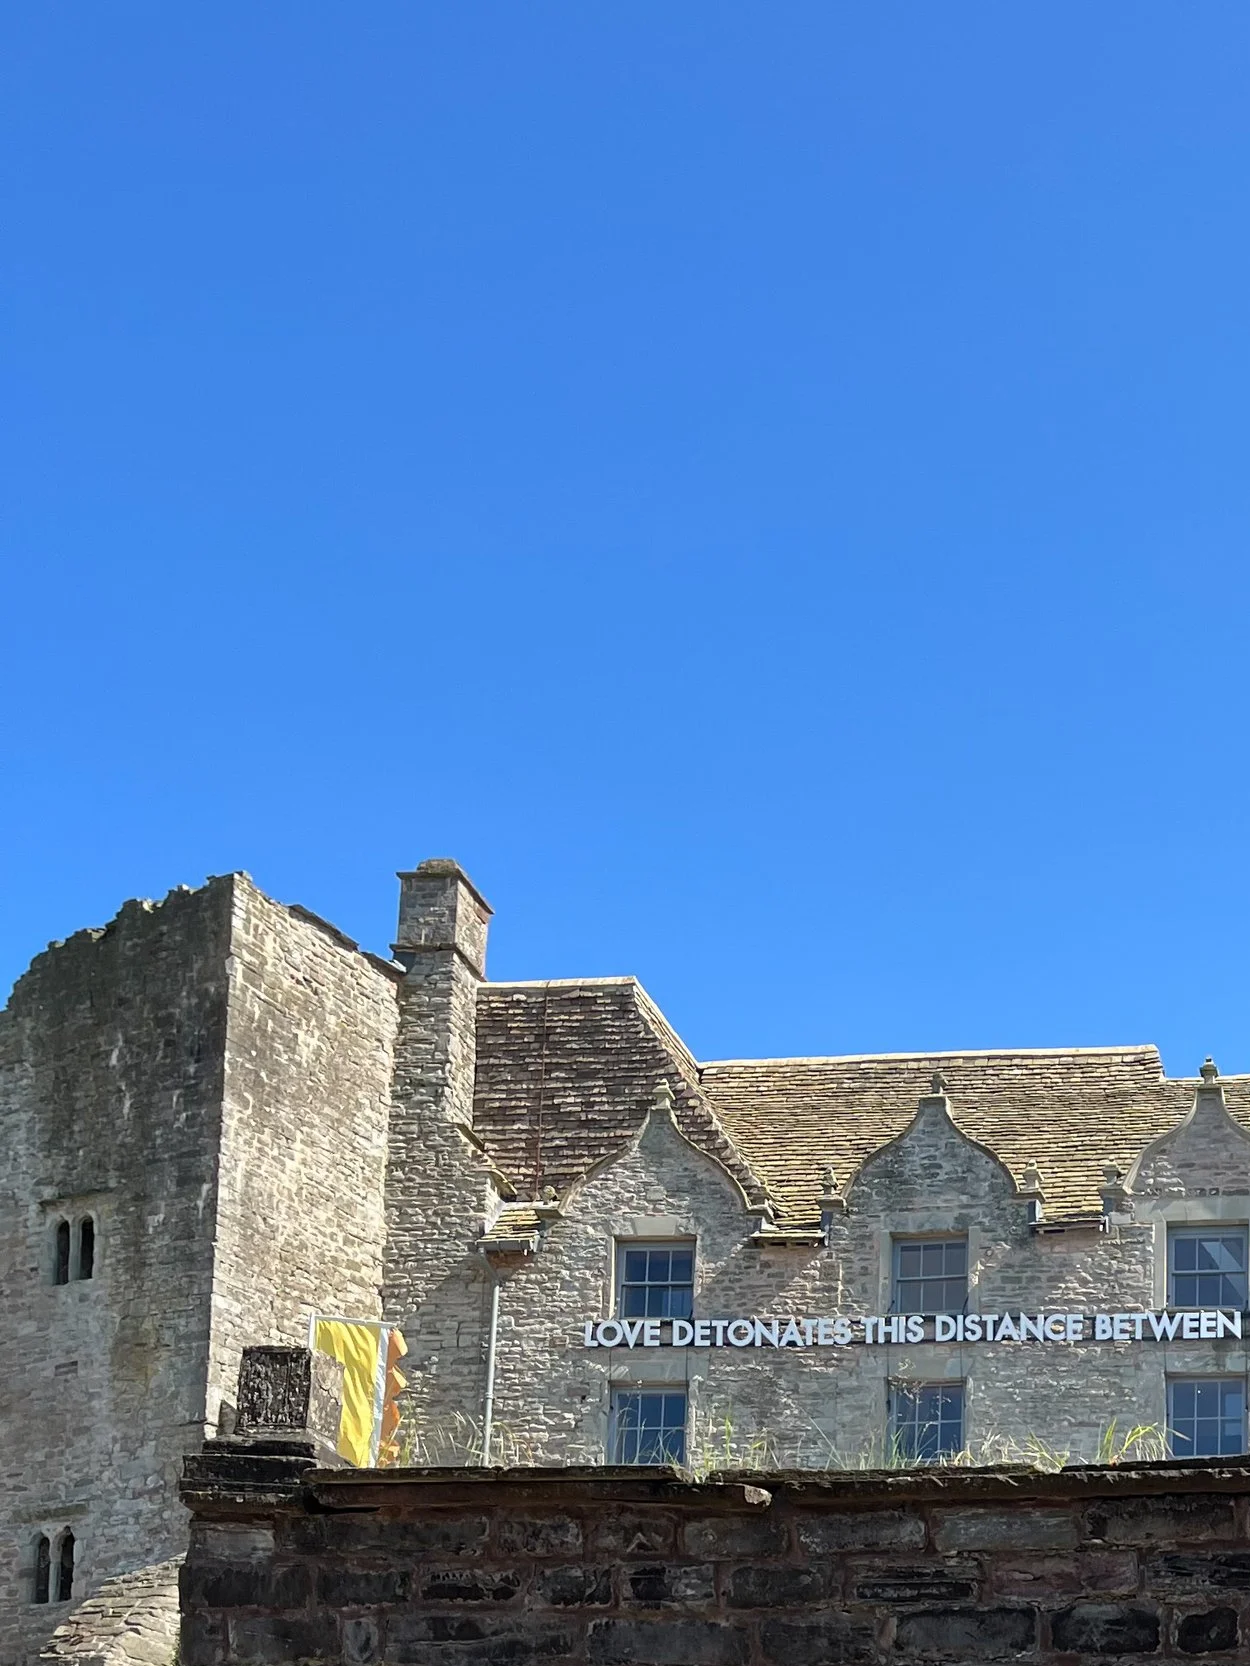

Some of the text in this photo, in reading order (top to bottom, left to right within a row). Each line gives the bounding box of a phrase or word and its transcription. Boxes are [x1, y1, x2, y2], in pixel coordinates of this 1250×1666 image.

[584, 1319, 662, 1348] LOVE
[671, 1316, 851, 1348] DETONATES
[859, 1314, 924, 1345] THIS
[934, 1312, 1083, 1343] DISTANCE
[1093, 1309, 1242, 1341] BETWEEN
